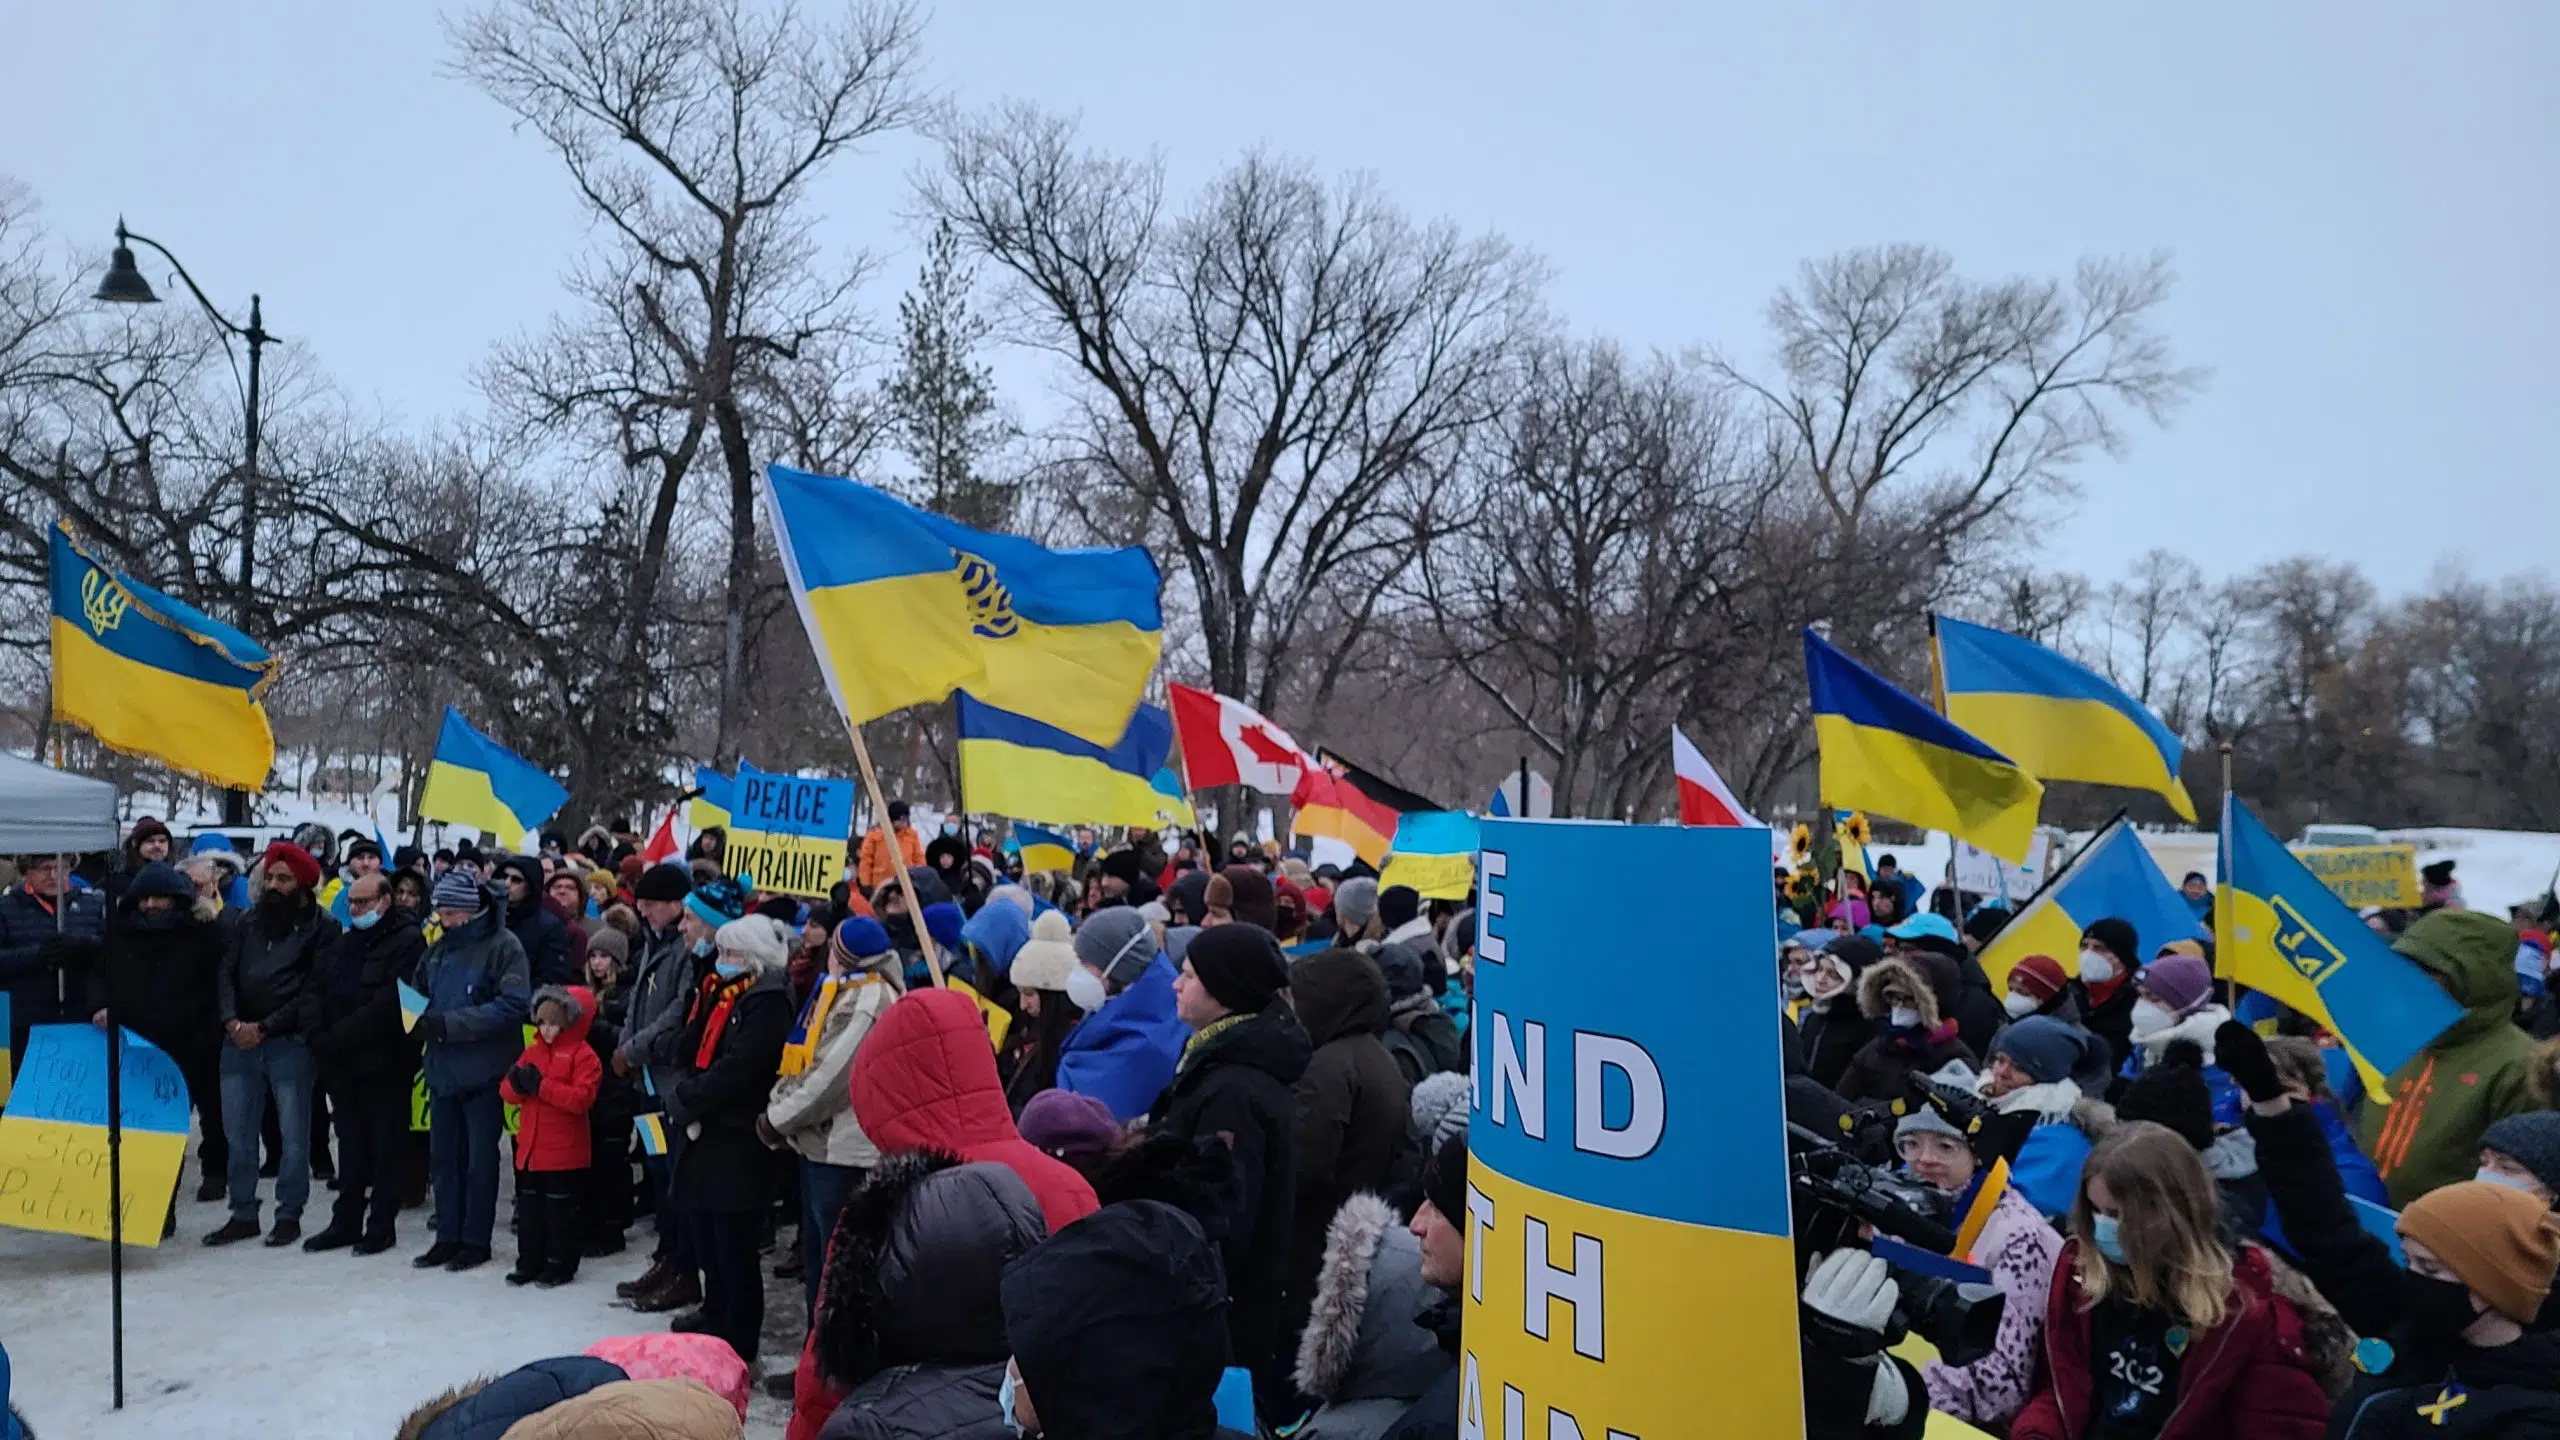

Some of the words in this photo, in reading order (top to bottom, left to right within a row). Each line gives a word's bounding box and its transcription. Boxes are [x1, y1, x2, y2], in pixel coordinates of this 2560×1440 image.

[744, 778, 829, 825] PEACE
[764, 824, 802, 849] FOR
[725, 844, 832, 894] UKRAINE
[26, 1129, 112, 1179] Stop
[1467, 1180, 1606, 1364] TH
